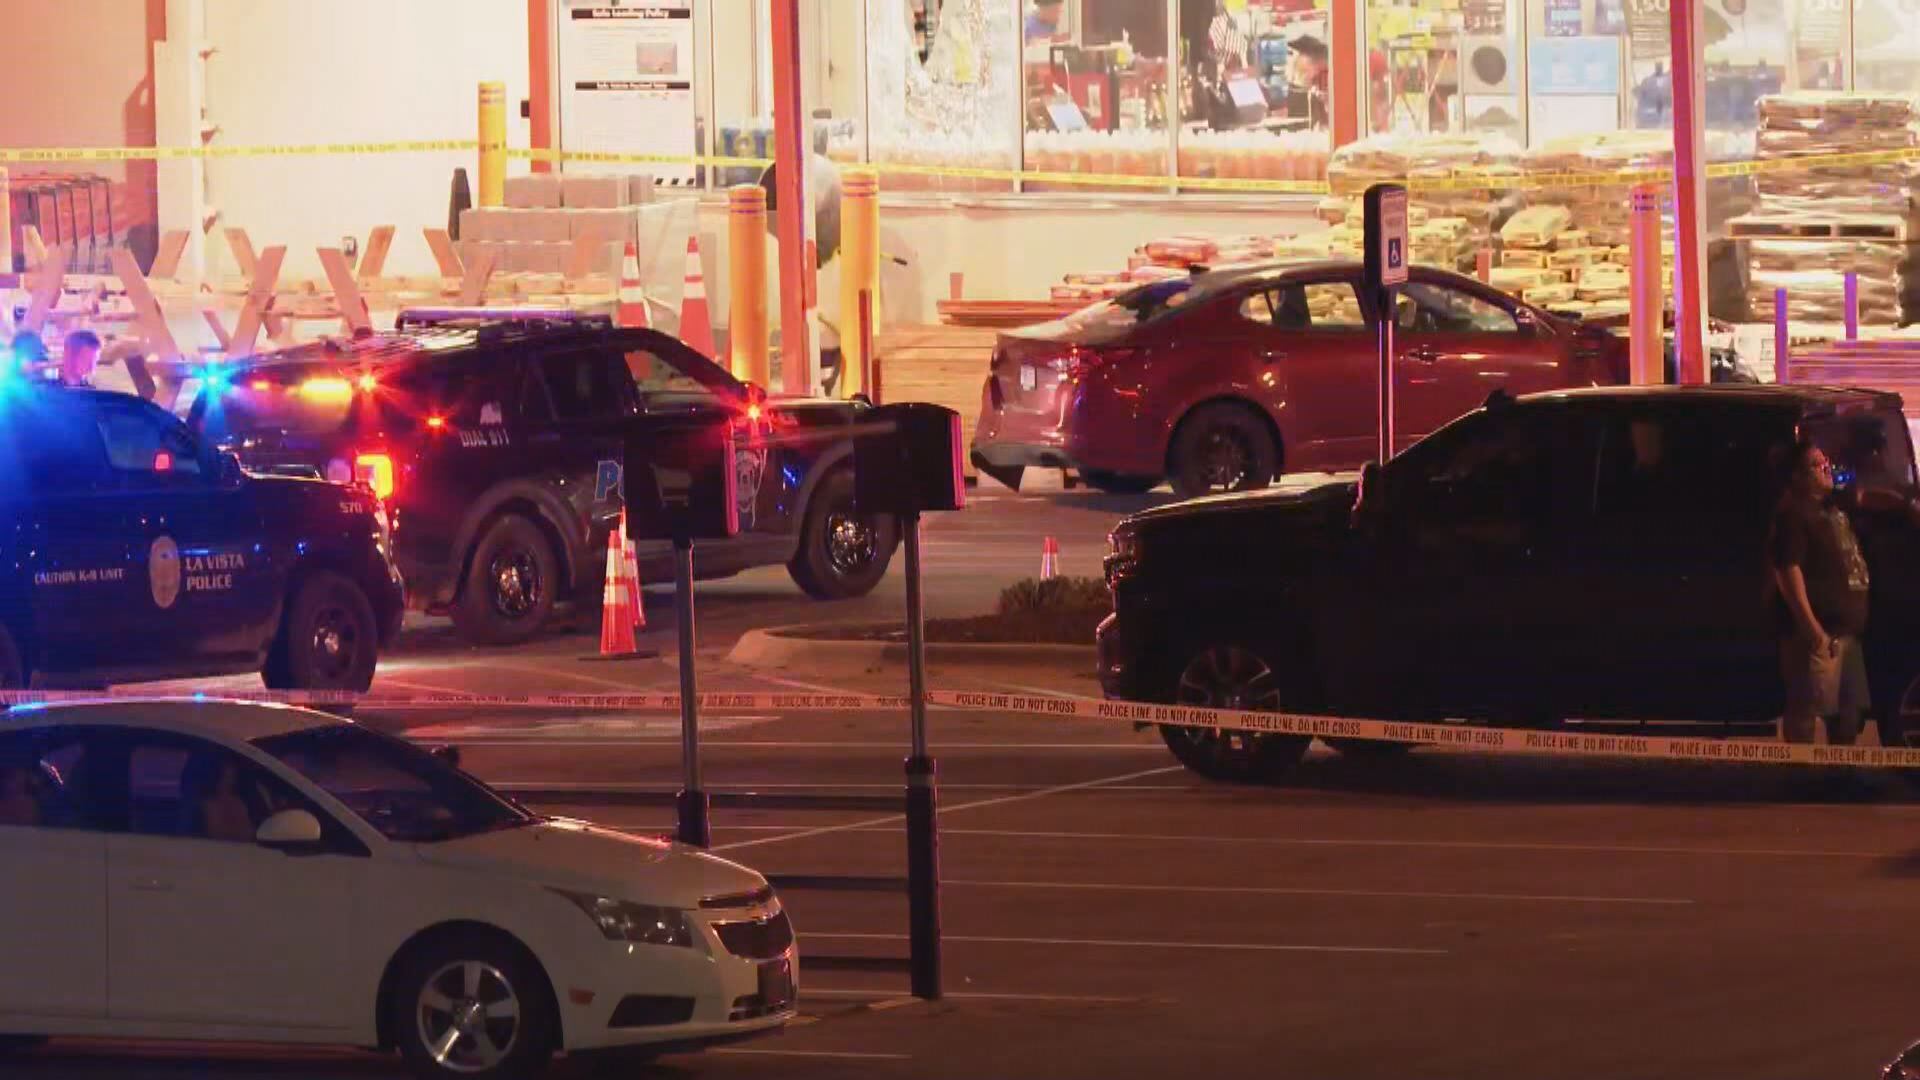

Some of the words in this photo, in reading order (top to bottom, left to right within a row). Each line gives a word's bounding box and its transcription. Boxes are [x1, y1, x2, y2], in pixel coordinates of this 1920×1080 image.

[185, 556, 203, 571] LA
[207, 554, 245, 570] VISTA
[34, 569, 76, 585] CAUTION
[100, 567, 124, 581] UNIT
[186, 574, 233, 591] POLICE
[956, 694, 987, 706] POLICE
[989, 696, 1009, 708] LINE
[1012, 698, 1025, 709] DO
[1027, 698, 1045, 710] NOT
[1047, 700, 1076, 713] CROSS
[1099, 704, 1129, 717] POLICE
[1131, 706, 1151, 719] LINE
[1155, 708, 1168, 720] DO
[1170, 708, 1187, 722] NOT
[1189, 710, 1218, 724] CROSS
[1240, 714, 1271, 728] POLICE
[1273, 717, 1293, 730] LINE
[1297, 719, 1310, 731] DO
[1312, 720, 1329, 733] NOT
[1332, 721, 1361, 735] CROSS
[1383, 724, 1414, 739] POLICE
[1416, 727, 1436, 740] LINE
[1440, 729, 1453, 741] DO
[1455, 730, 1472, 743] NOT
[1475, 731, 1504, 745] CROSS
[1526, 734, 1556, 748] POLICE
[1559, 736, 1580, 749] LINE
[1583, 738, 1596, 750] DO
[1599, 738, 1616, 751] NOT
[1618, 739, 1648, 753] CROSS
[1669, 742, 1700, 755] POLICE
[1703, 743, 1722, 755] LINE
[1726, 744, 1739, 757] DO
[1741, 744, 1760, 758] NOT
[1761, 745, 1791, 760] CROSS
[1813, 748, 1843, 761] POLICE
[1846, 749, 1865, 762] LINE
[1870, 750, 1883, 762] DO
[1886, 751, 1903, 763] NOT
